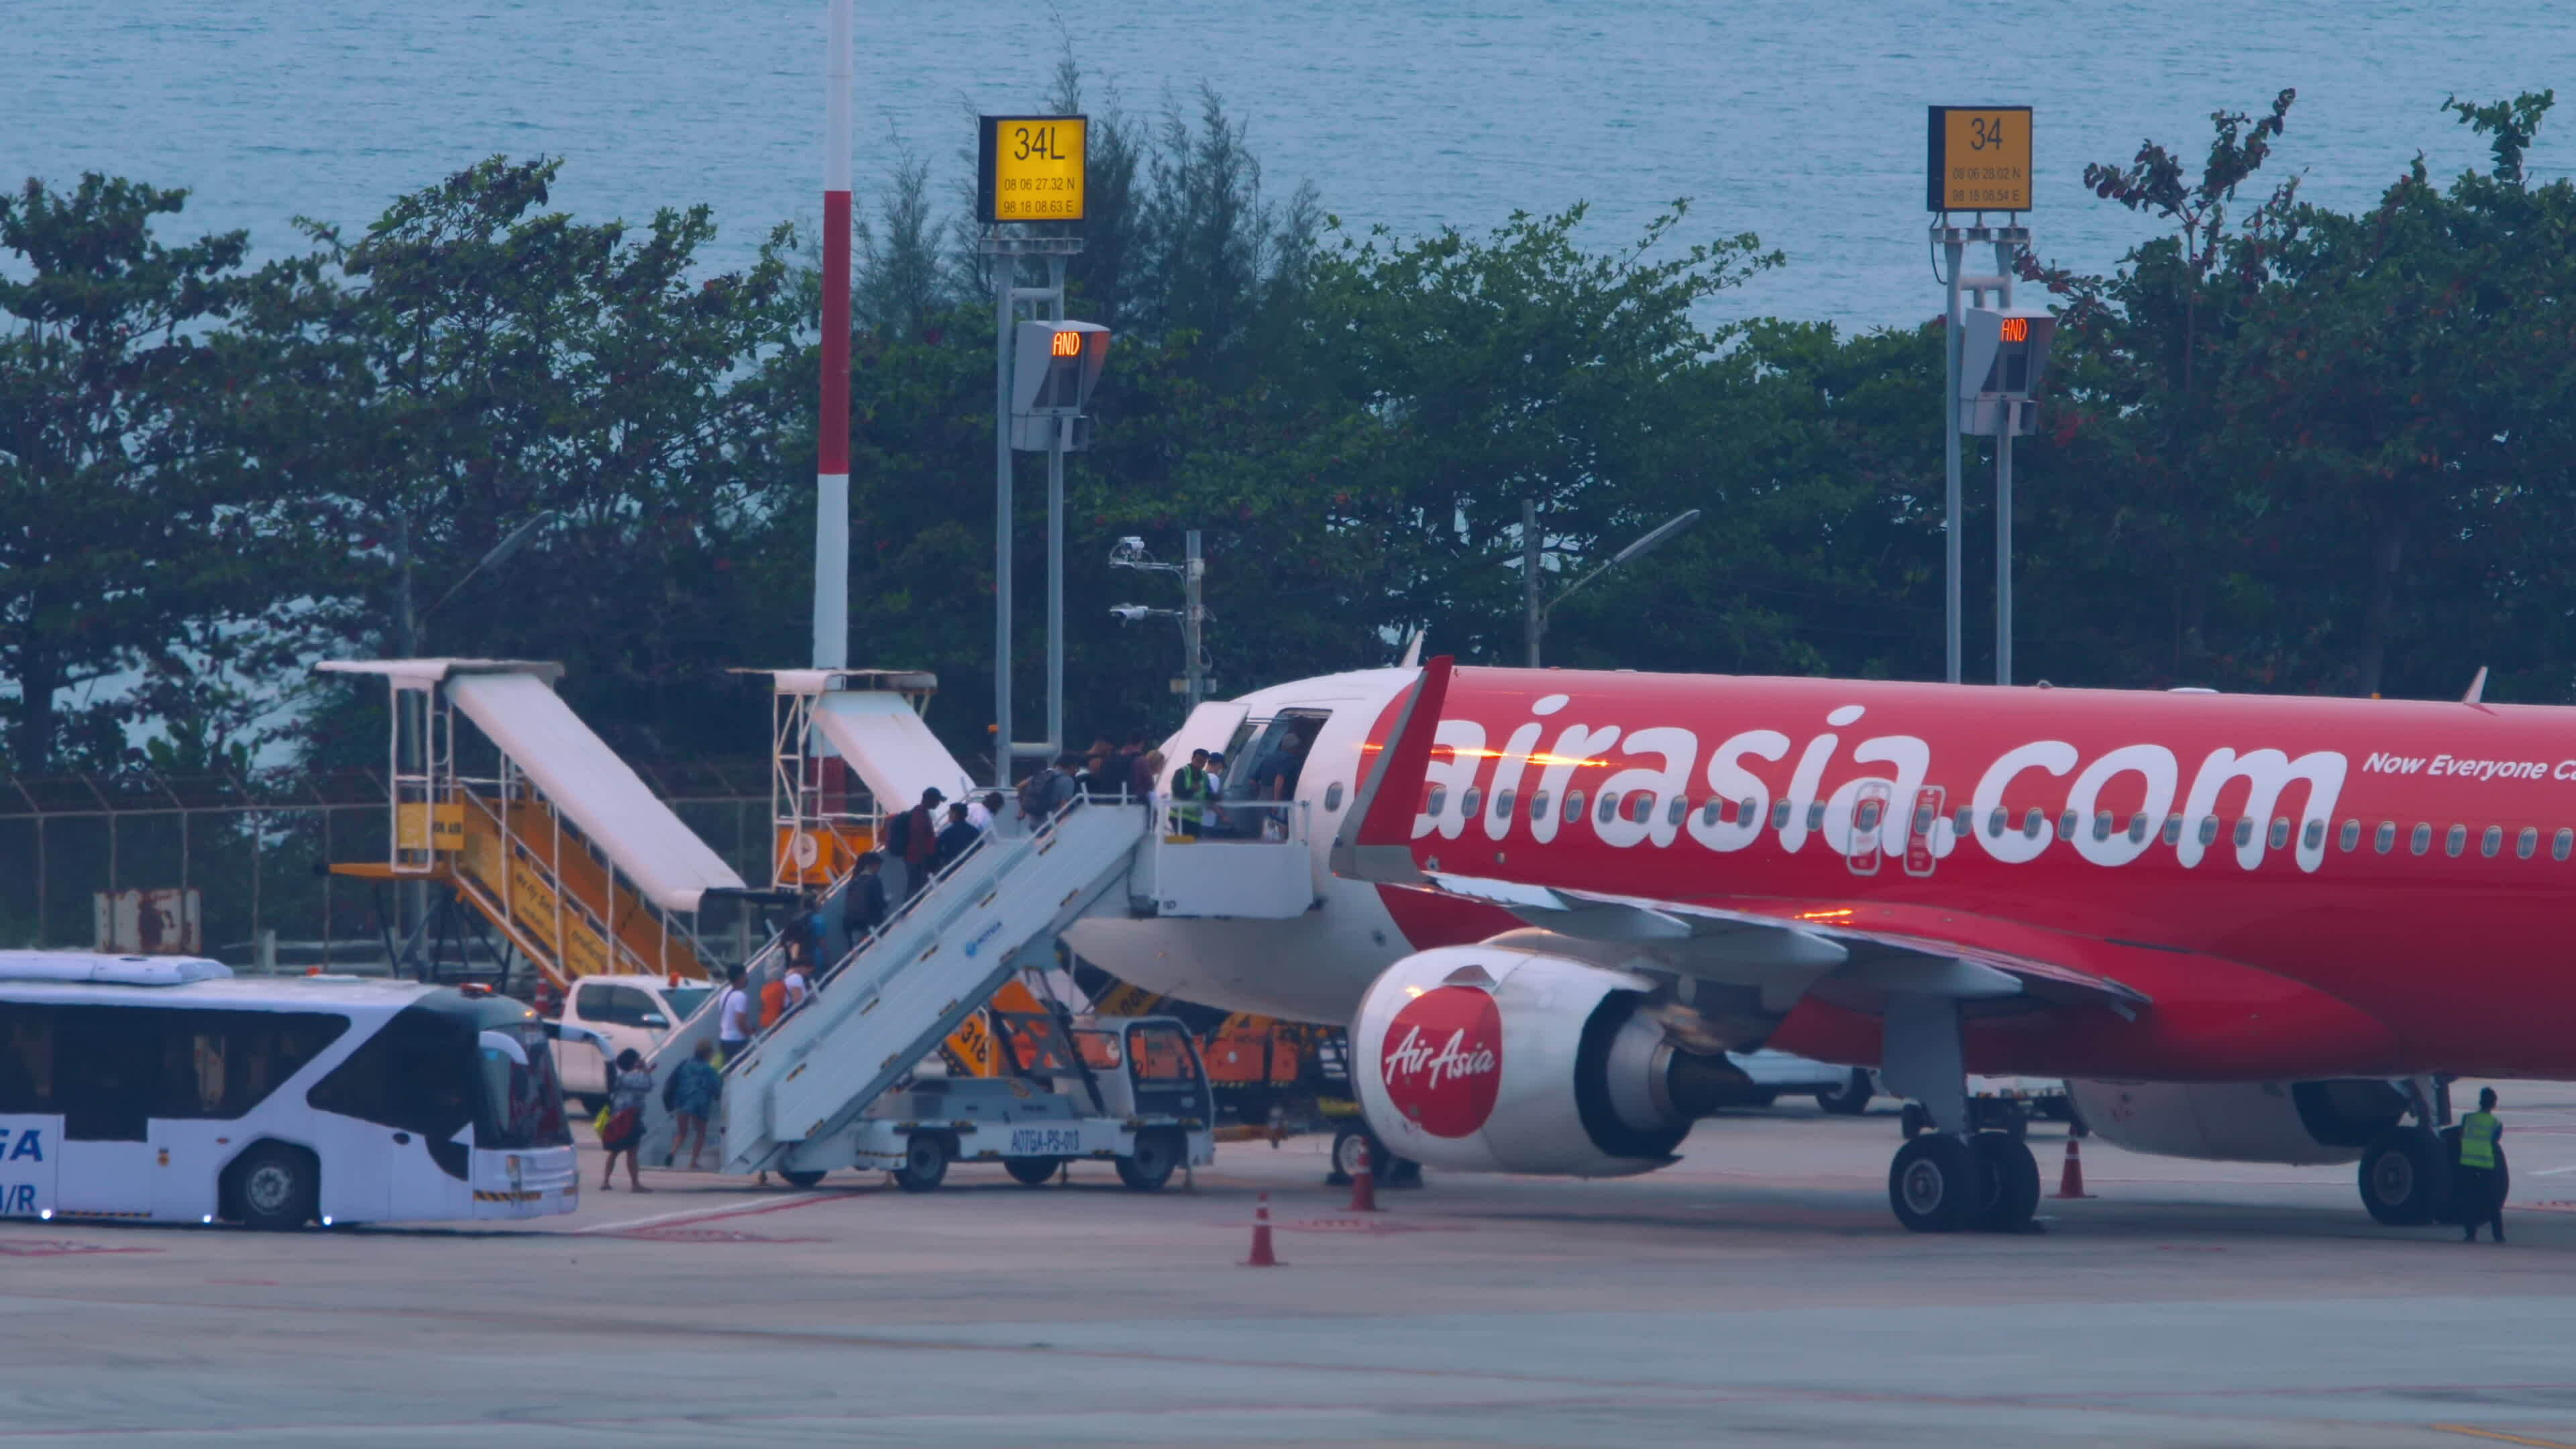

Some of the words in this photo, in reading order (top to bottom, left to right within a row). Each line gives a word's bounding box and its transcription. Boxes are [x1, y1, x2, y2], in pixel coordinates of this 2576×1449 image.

[1014, 127, 1065, 160] 34L
[1970, 117, 2002, 150] 34
[1004, 178, 1017, 191] 08
[1020, 178, 1032, 191] 06
[1035, 178, 1063, 191] 27.32
[1067, 177, 1075, 189] N
[2013, 167, 2021, 179] N
[1004, 201, 1016, 213] 98
[1020, 201, 1031, 213] 18
[1066, 201, 1073, 212] E
[2013, 190, 2019, 201] E
[1053, 331, 1081, 356] AND
[2001, 318, 2027, 342] AND
[2362, 752, 2426, 774] Now
[2427, 755, 2548, 782] Everyone
[1411, 694, 2348, 873] airasia.com
[1385, 1024, 1434, 1085] Air
[1428, 1028, 1495, 1090] Asia
[0, 1184, 36, 1216] /R
